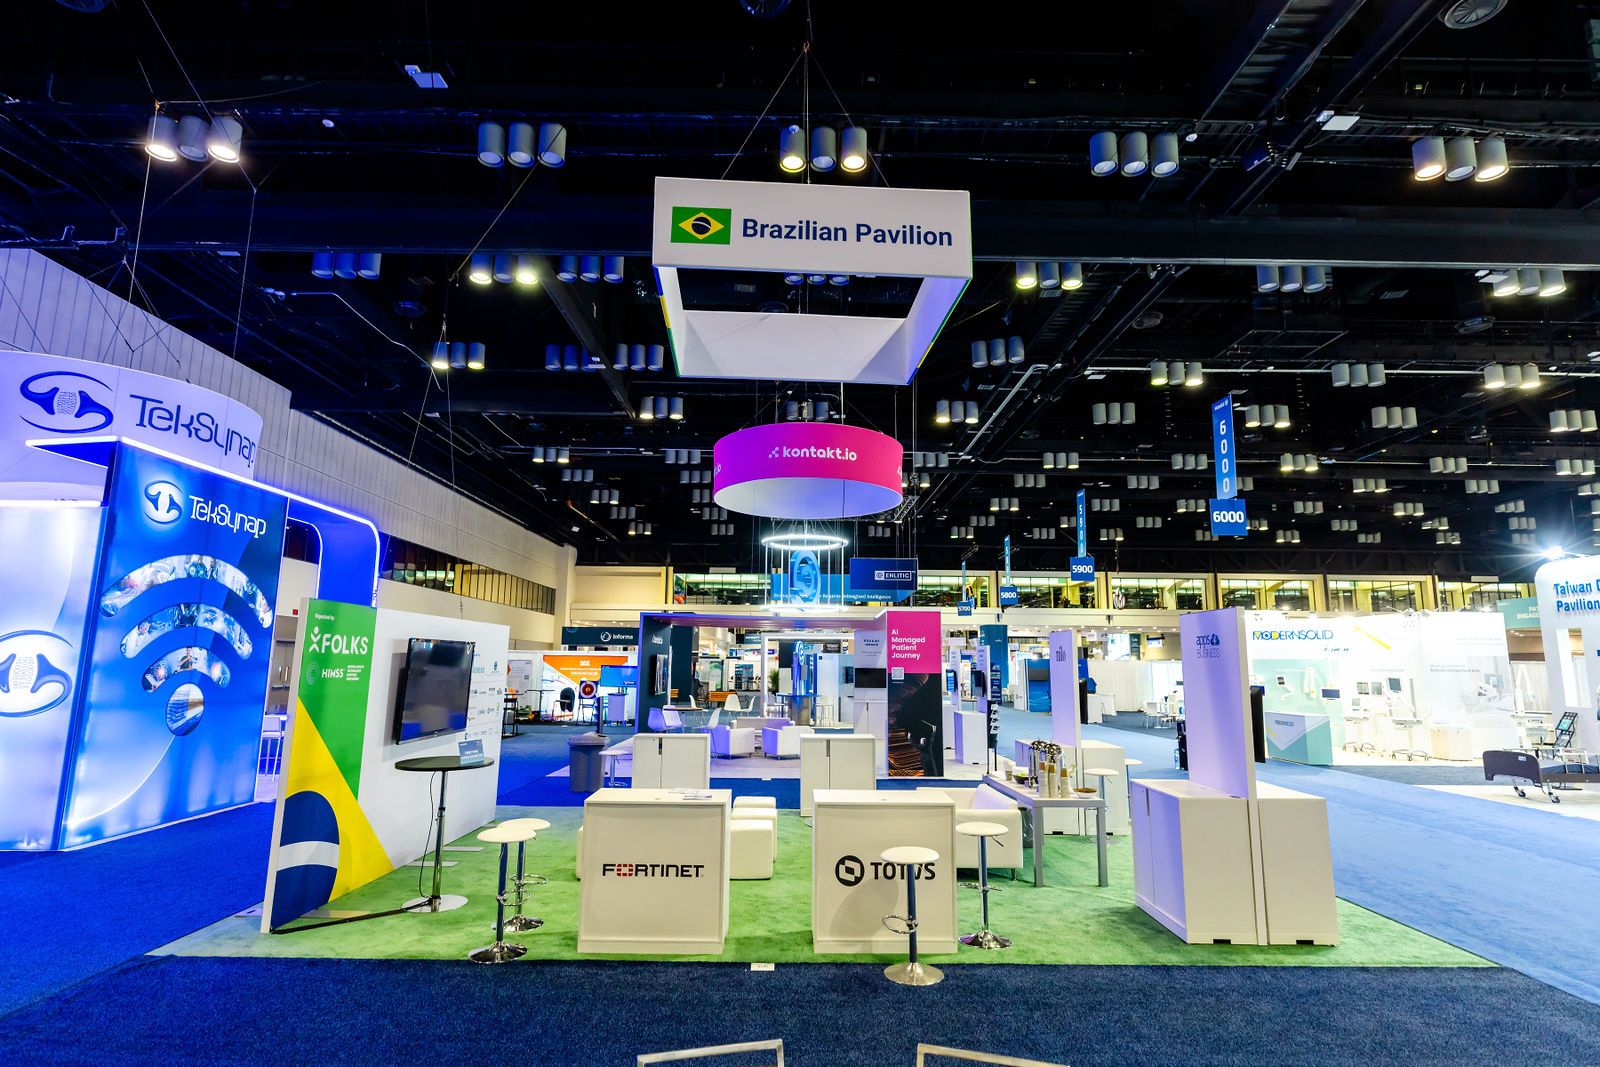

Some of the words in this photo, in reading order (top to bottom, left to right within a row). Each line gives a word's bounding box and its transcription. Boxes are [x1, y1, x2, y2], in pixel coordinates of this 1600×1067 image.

[742, 218, 847, 242] Brazilian
[855, 223, 952, 246] Pavilion
[129, 393, 256, 469] TekSynap
[783, 445, 857, 461] kontakt.io
[189, 495, 267, 539] TekSynap
[1213, 510, 1245, 523] 6000
[1072, 565, 1093, 574] 5900
[1553, 580, 1592, 595] Taiwan
[1557, 598, 1600, 612] Pavilion
[1196, 635, 1210, 648] apps
[1253, 630, 1333, 640] MODERNSOLID
[321, 633, 369, 655] FOLKS
[891, 652, 921, 660] Journey
[321, 668, 344, 678] HIMSS
[602, 863, 705, 878] FORTINET
